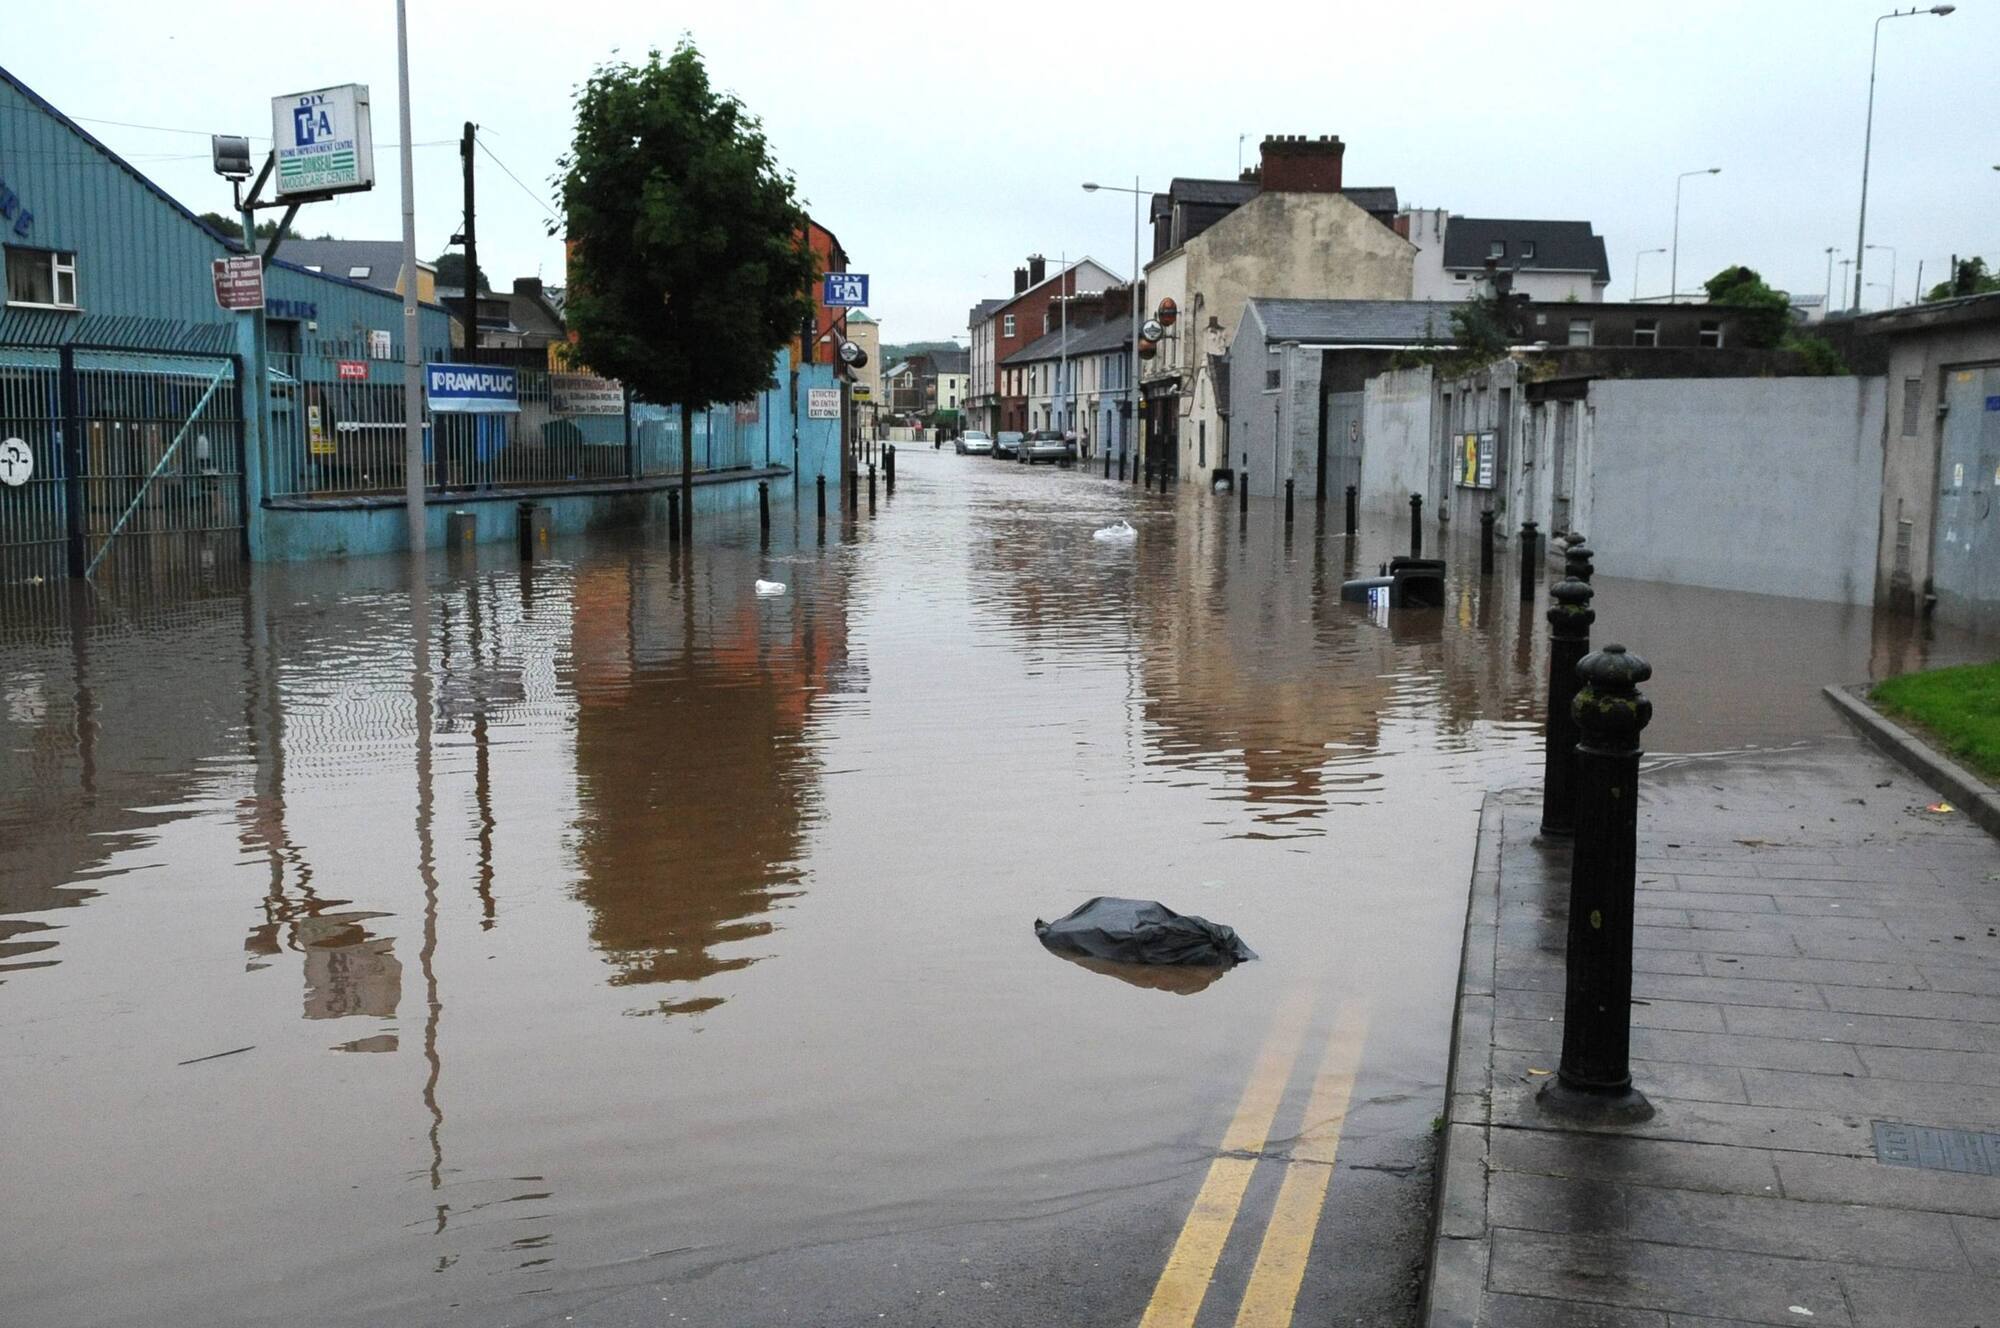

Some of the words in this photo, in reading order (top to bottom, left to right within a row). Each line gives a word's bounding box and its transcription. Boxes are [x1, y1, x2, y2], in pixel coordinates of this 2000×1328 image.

[299, 94, 325, 106] DIY
[296, 143, 332, 156] IMPROVEMENT
[334, 139, 353, 149] CENTRE
[281, 173, 325, 188] WOODCARE
[326, 168, 355, 184] CENTRE
[445, 372, 513, 392] RAWLPLUG
[811, 390, 837, 398] STRICTLY
[823, 409, 839, 417] ONLY
